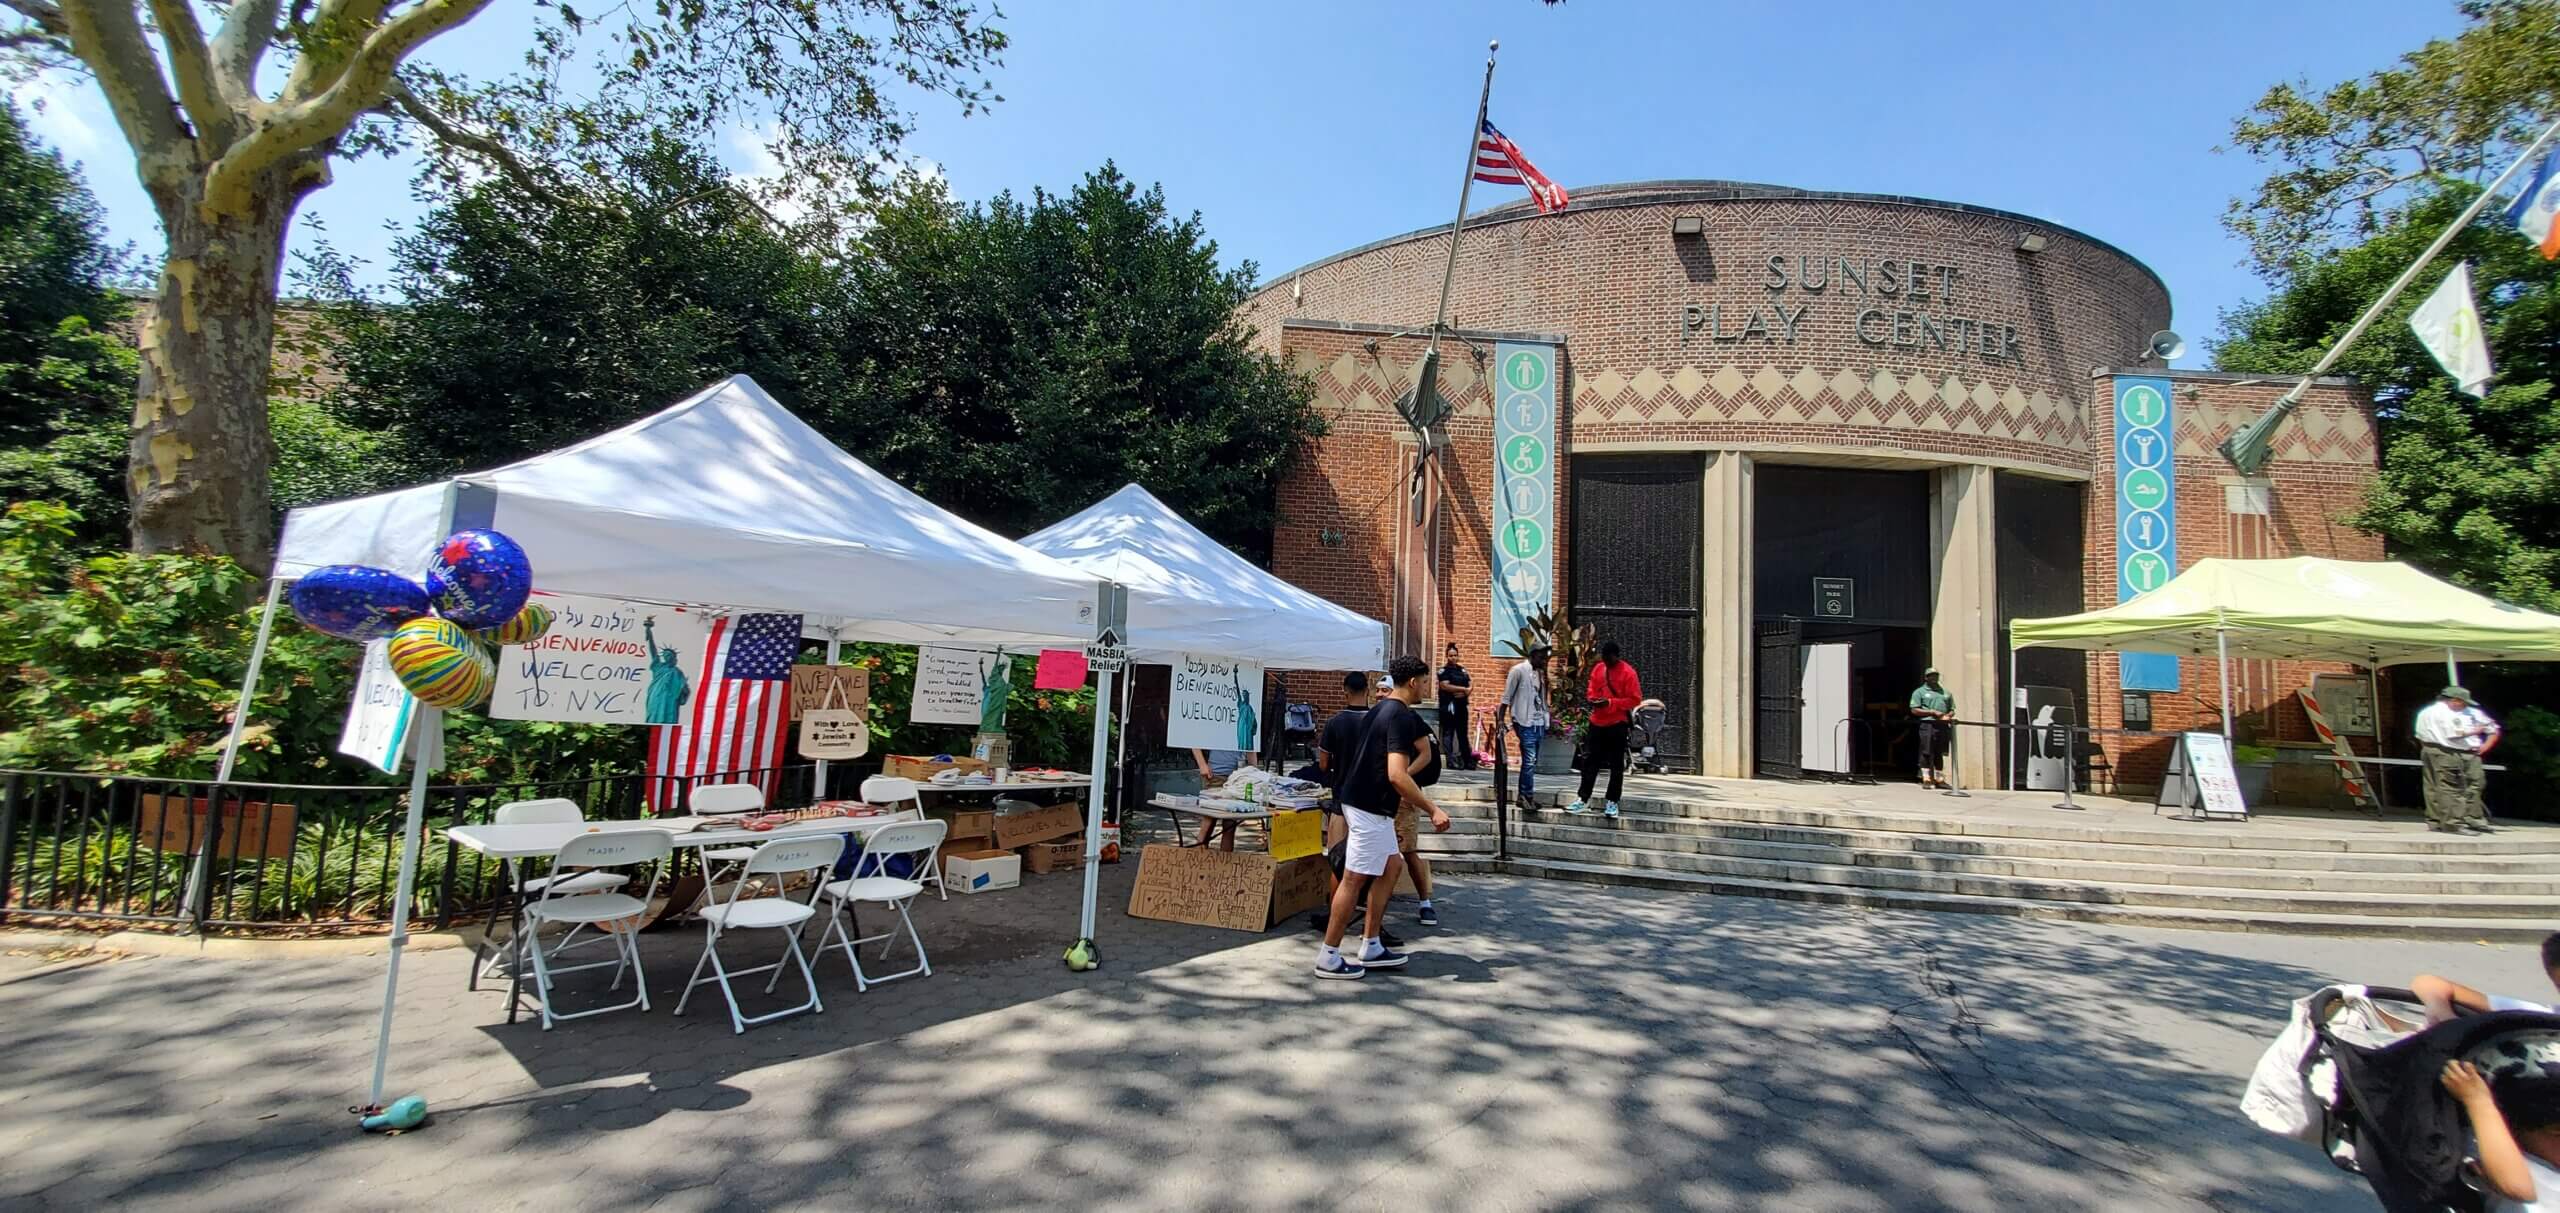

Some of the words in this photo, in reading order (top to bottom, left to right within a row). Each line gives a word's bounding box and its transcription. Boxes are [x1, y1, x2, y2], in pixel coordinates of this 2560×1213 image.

[1765, 255, 1960, 300] SUNSET
[1682, 303, 1808, 343] PLAY
[1856, 308, 2024, 362] CENTER
[1086, 647, 1125, 660] MASBIA
[1090, 659, 1121, 671] Relief
[522, 661, 646, 682] WELCOME
[1177, 673, 1238, 701] BIENVENIDOS
[566, 688, 642, 715] NYC!
[1181, 700, 1237, 725] WELCOME
